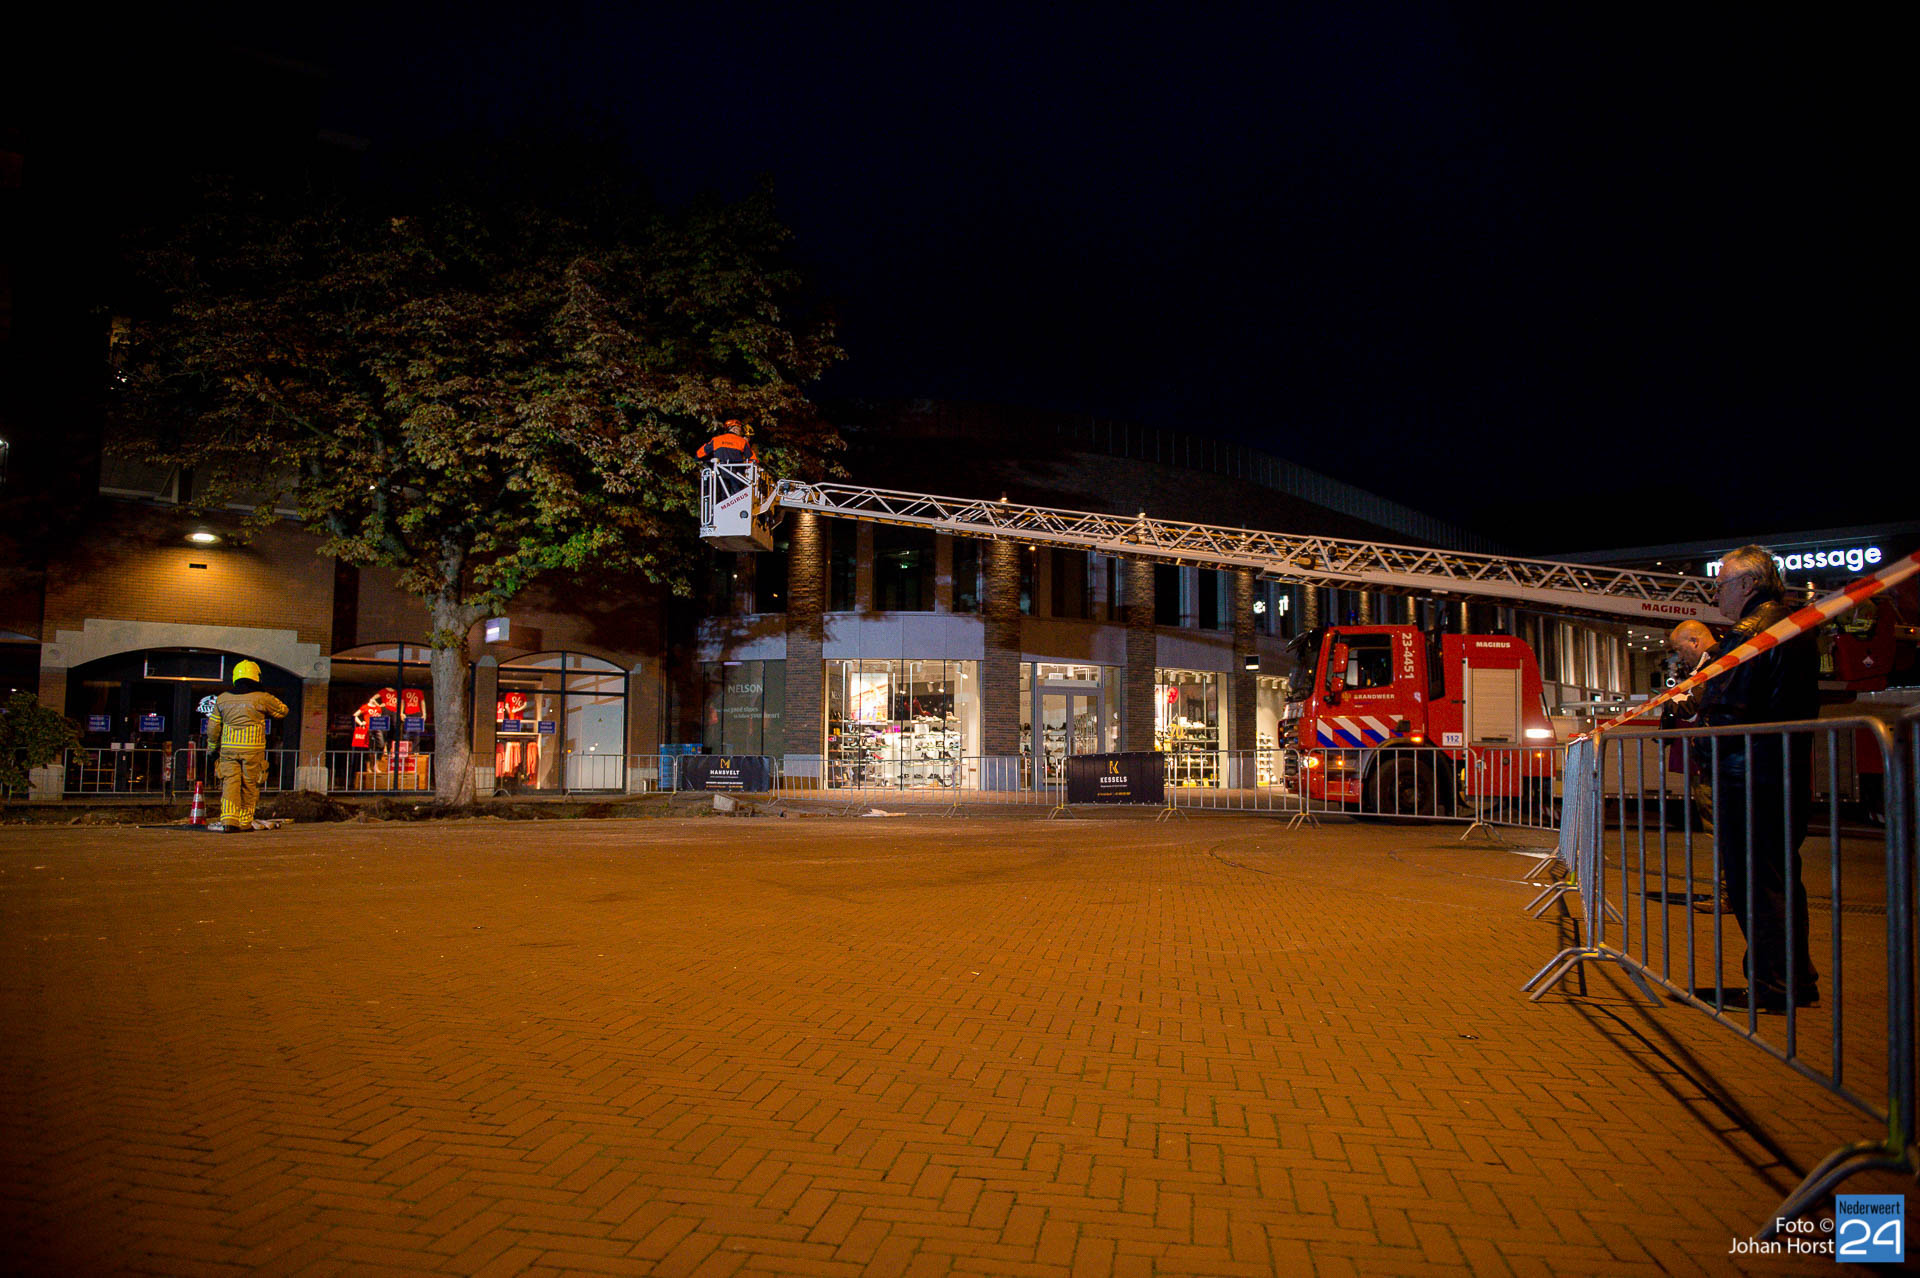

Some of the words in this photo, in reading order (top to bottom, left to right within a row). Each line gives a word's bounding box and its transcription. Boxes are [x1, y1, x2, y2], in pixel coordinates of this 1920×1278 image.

[720, 492, 749, 510] MAGIRUS
[1641, 602, 1697, 616] MAGIRUS
[1475, 641, 1511, 649] MAGIRUS
[1402, 632, 1415, 679] 23-4451
[728, 684, 763, 694] NELSON
[1446, 735, 1459, 743] 112
[1100, 776, 1128, 784] KESSELS
